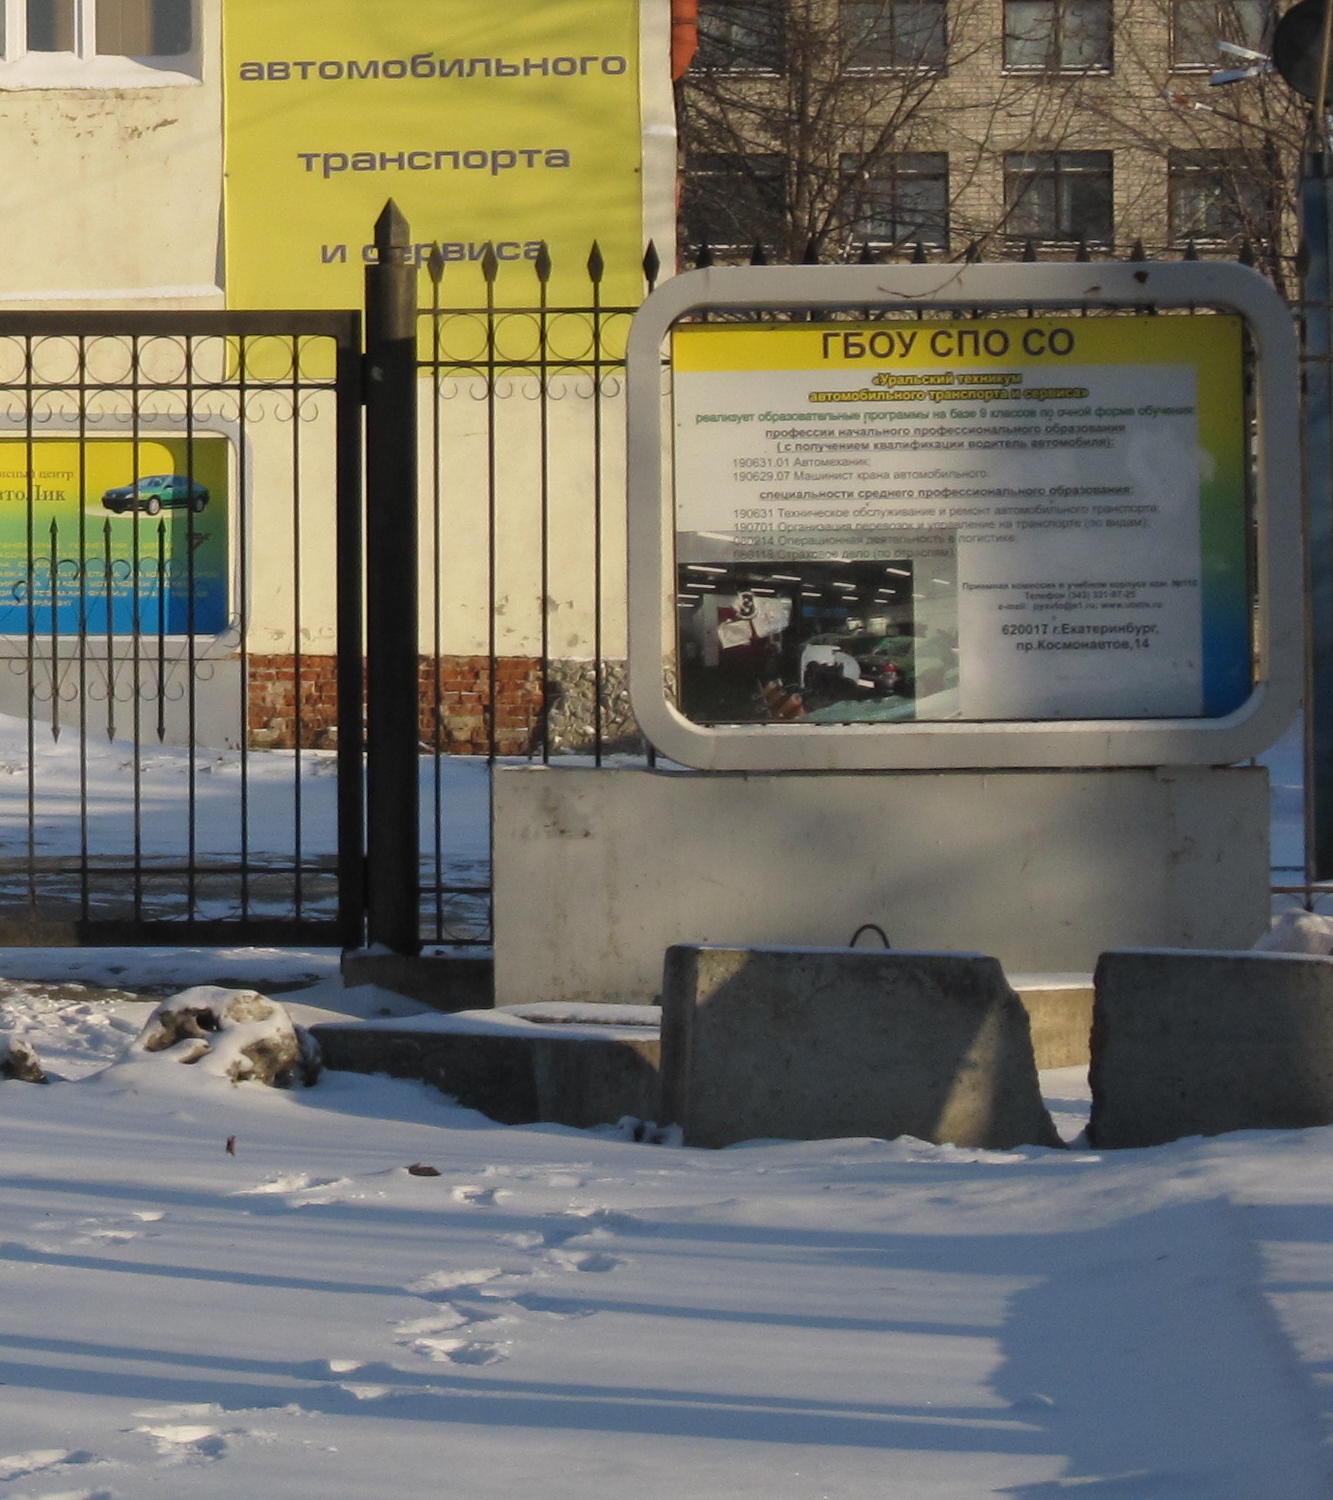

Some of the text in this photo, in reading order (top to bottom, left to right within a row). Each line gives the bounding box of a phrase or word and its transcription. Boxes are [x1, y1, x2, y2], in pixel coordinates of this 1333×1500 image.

[239, 52, 627, 81] автомобильного
[298, 149, 570, 178] транспорта
[321, 244, 347, 263] и
[822, 328, 1075, 359] ГБОУ СПО СО
[872, 372, 1023, 388] «Уральский техникум
[809, 389, 925, 402] автомобильного
[930, 389, 1008, 402] транспорта
[1010, 389, 1021, 400] и
[696, 412, 754, 424] реализует
[758, 411, 860, 422] образовательные
[864, 411, 929, 423] программы
[933, 410, 947, 418] на
[951, 408, 977, 418] базе
[980, 408, 987, 418] 9
[991, 409, 1037, 418] классов
[1040, 408, 1054, 418] по
[1057, 407, 1091, 417] очной
[1095, 407, 1134, 419] форме
[765, 427, 836, 439] профессии
[838, 427, 910, 438] начального
[914, 425, 1042, 438] профессионального
[795, 441, 869, 452] получением
[873, 439, 964, 451] квалификации
[968, 438, 1027, 450] водитель
[733, 457, 790, 468] 190631.01
[39, 471, 74, 481] центр
[733, 471, 790, 481] 190629.07
[793, 471, 853, 481] Машинист
[857, 471, 889, 481] крана
[760, 489, 854, 500] специальности
[858, 488, 913, 500] среднего
[918, 485, 1046, 499] профессионального
[733, 509, 773, 518] 190631
[778, 508, 849, 518] Техническое
[853, 506, 935, 518] обслуживание
[949, 506, 991, 517] ремонт
[994, 504, 1088, 516] автомобильного
[1002, 623, 1048, 635] 620017
[1016, 638, 1150, 652] пр.Космонавтов,14
